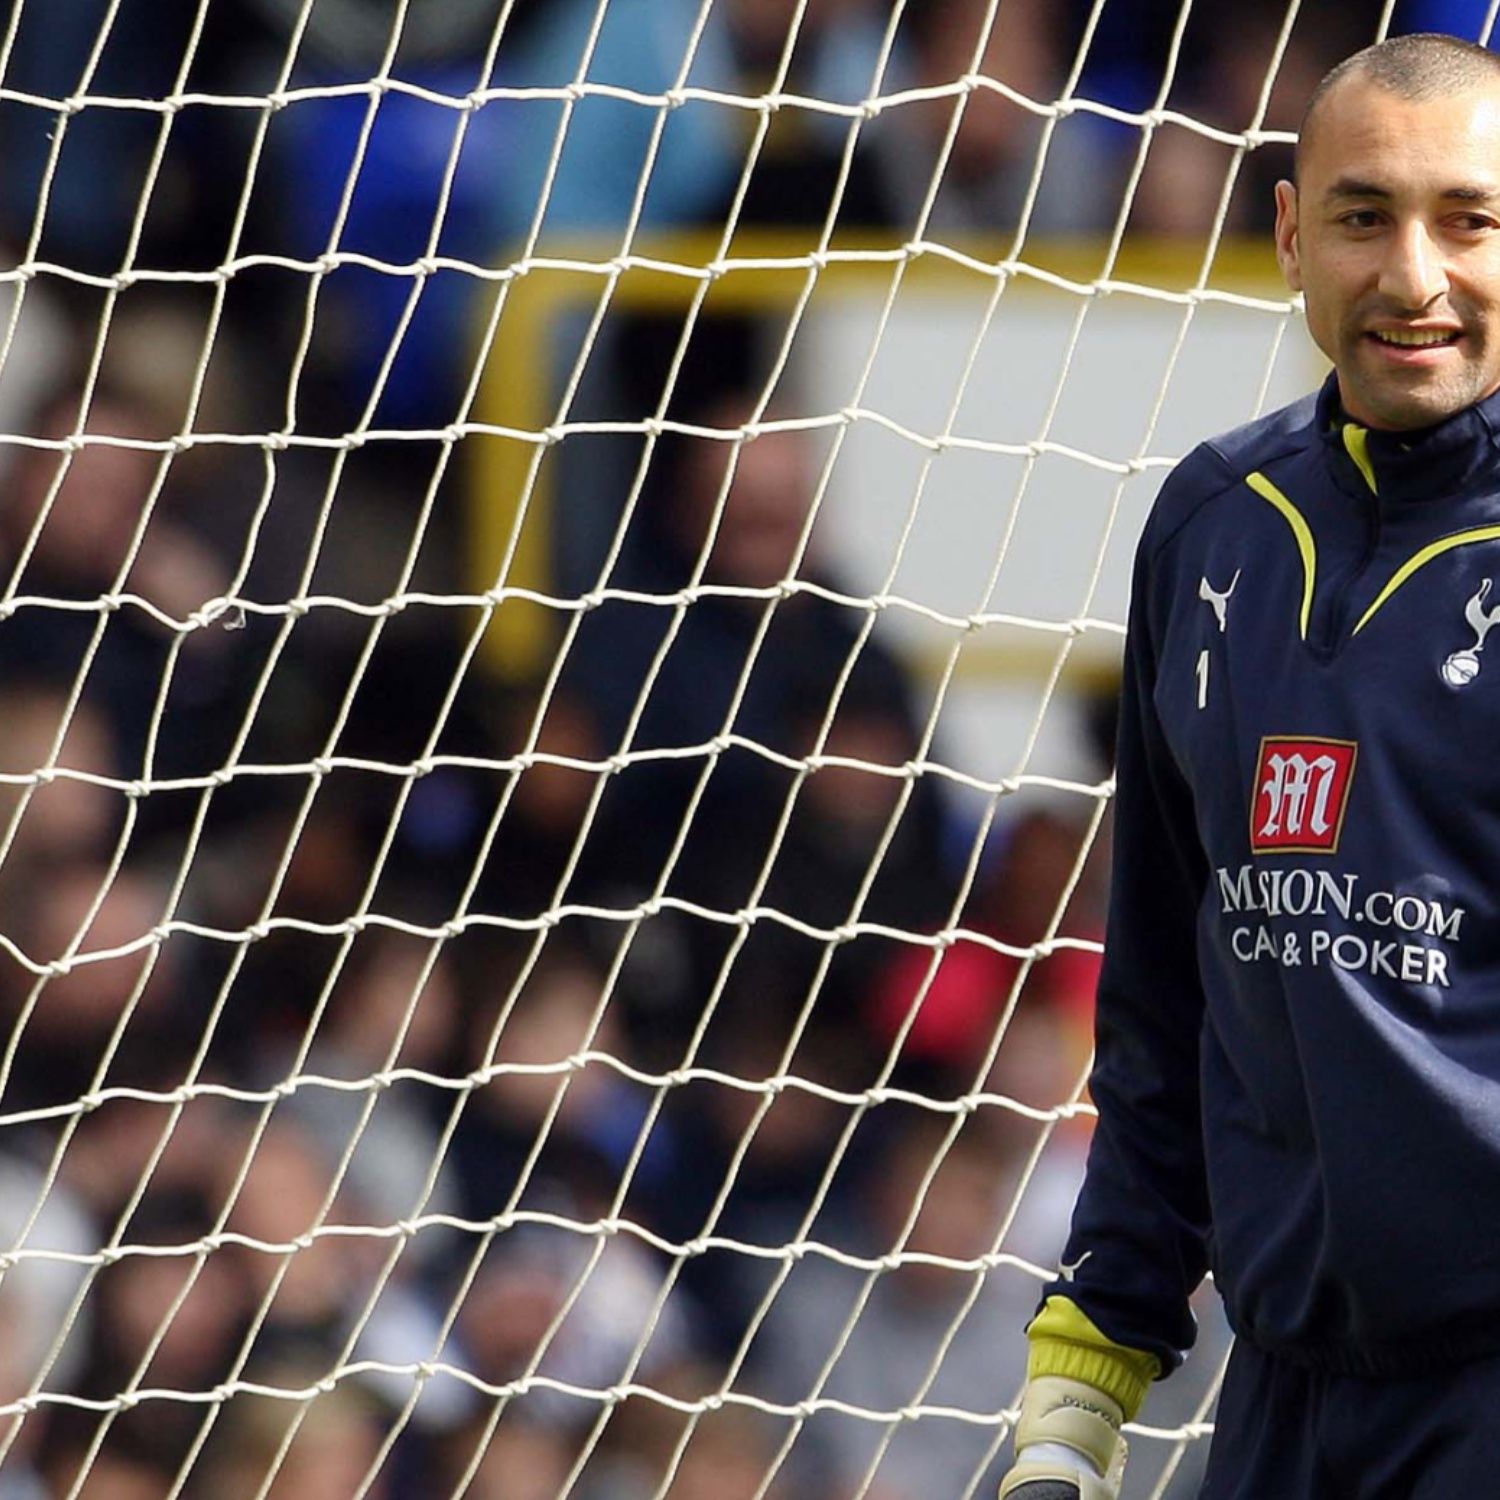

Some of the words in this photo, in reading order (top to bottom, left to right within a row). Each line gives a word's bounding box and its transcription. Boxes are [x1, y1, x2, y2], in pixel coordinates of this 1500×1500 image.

[1195, 650, 1209, 709] 1
[1258, 753, 1337, 838] M
[1282, 931, 1301, 967] &
[1310, 929, 1450, 987] POKER
